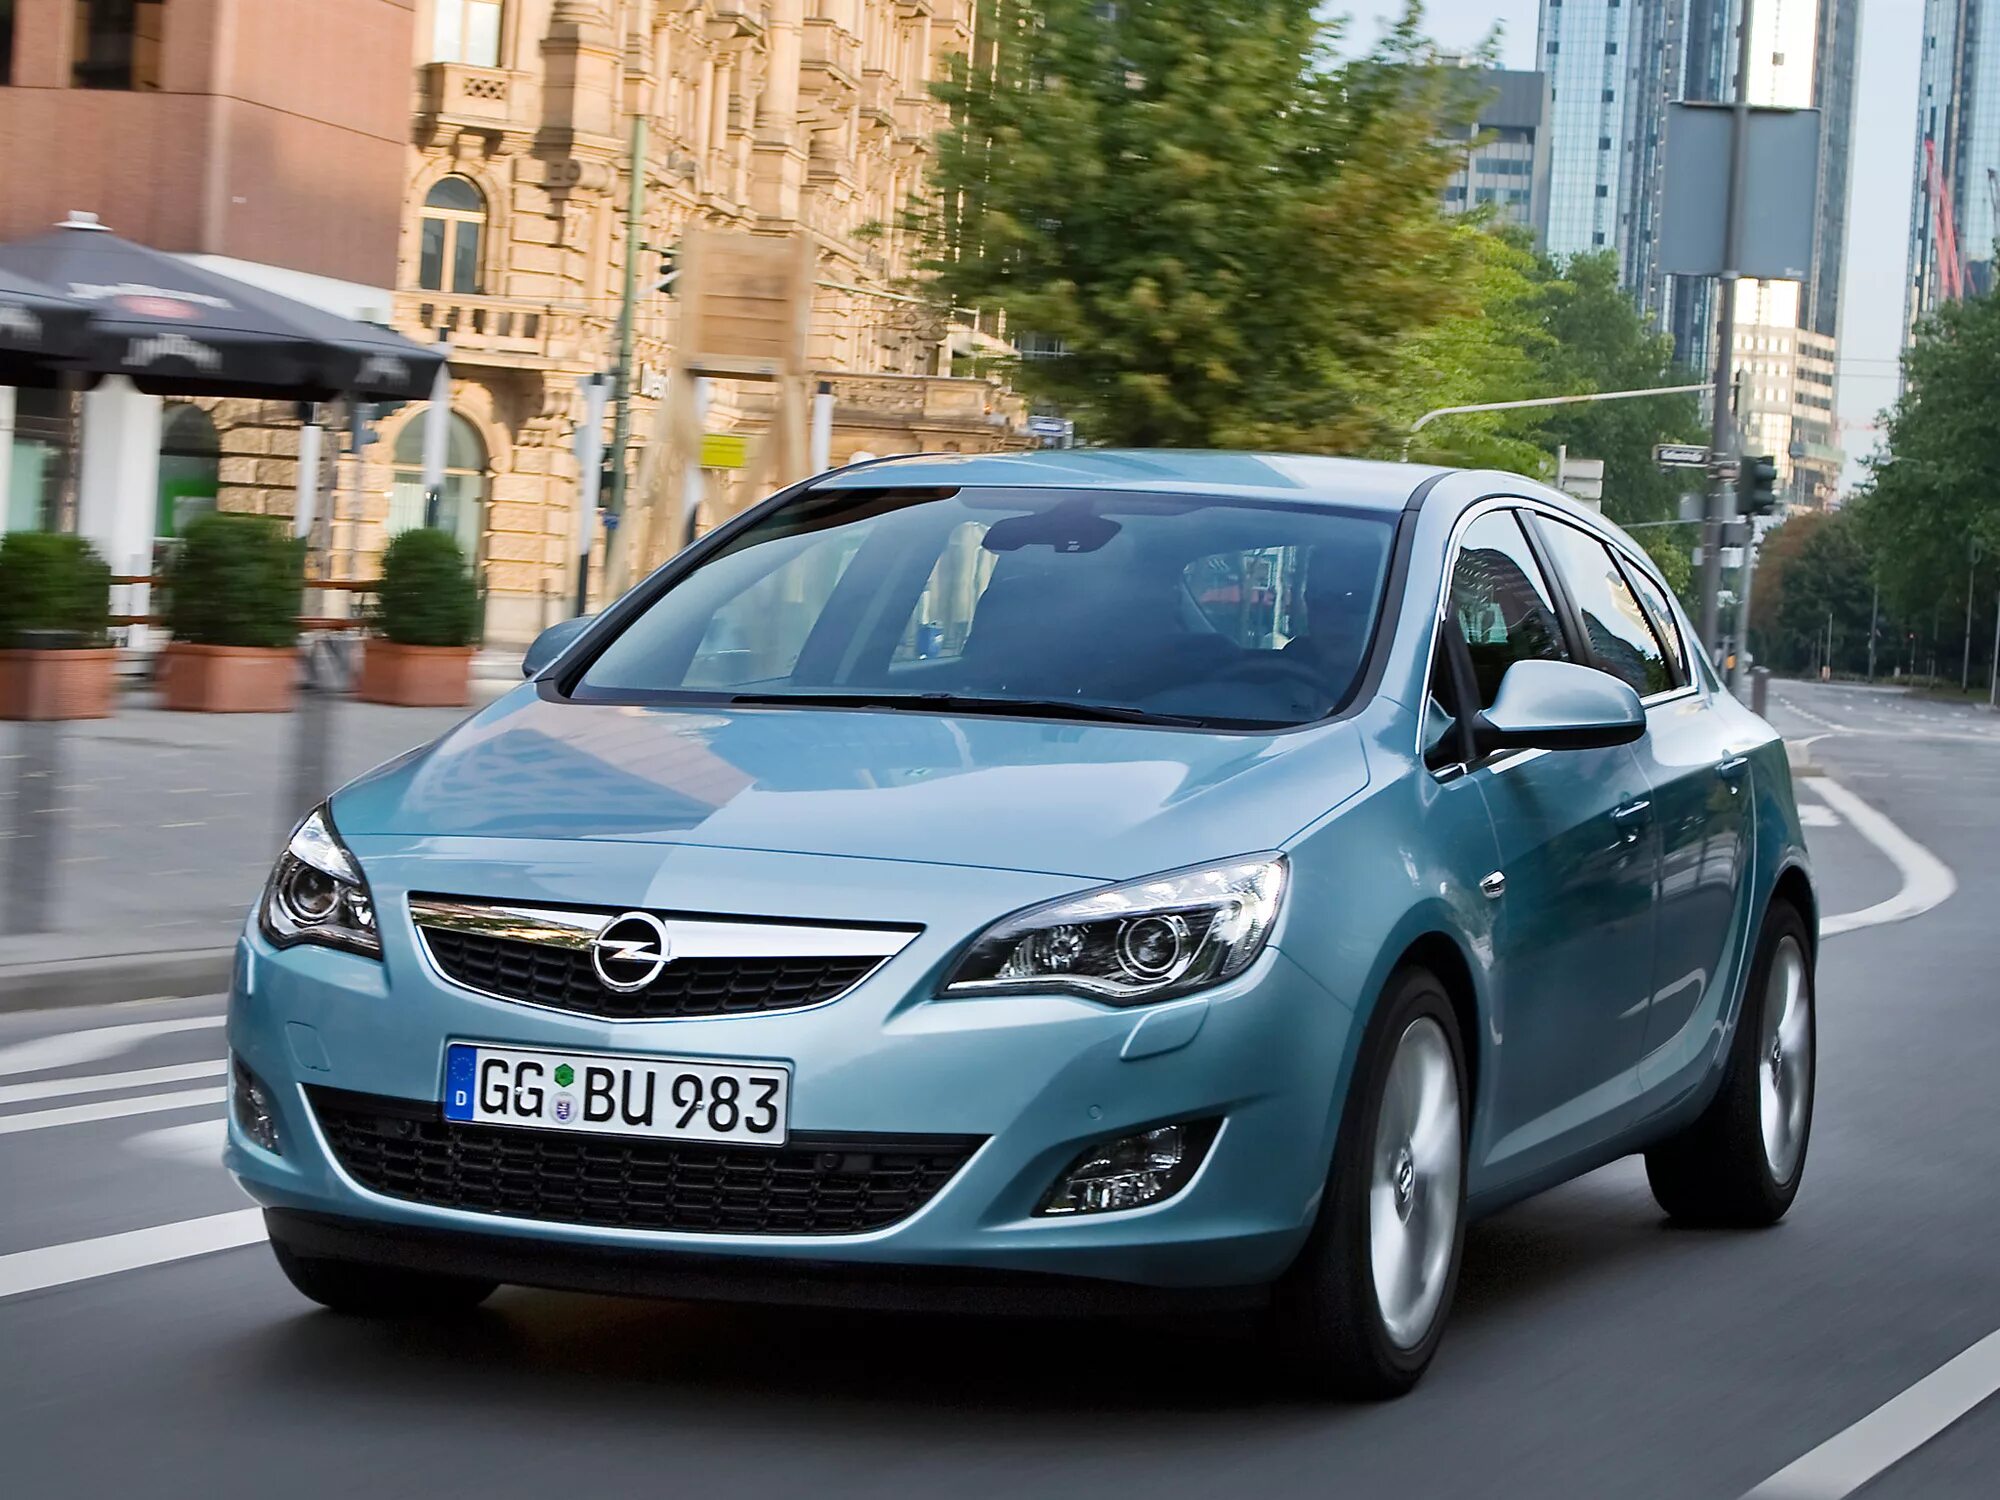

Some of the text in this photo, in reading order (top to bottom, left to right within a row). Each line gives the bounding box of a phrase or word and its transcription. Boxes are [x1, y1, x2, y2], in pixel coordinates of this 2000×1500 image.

[455, 1090, 467, 1106] D
[480, 1058, 779, 1134] GG BU 983
